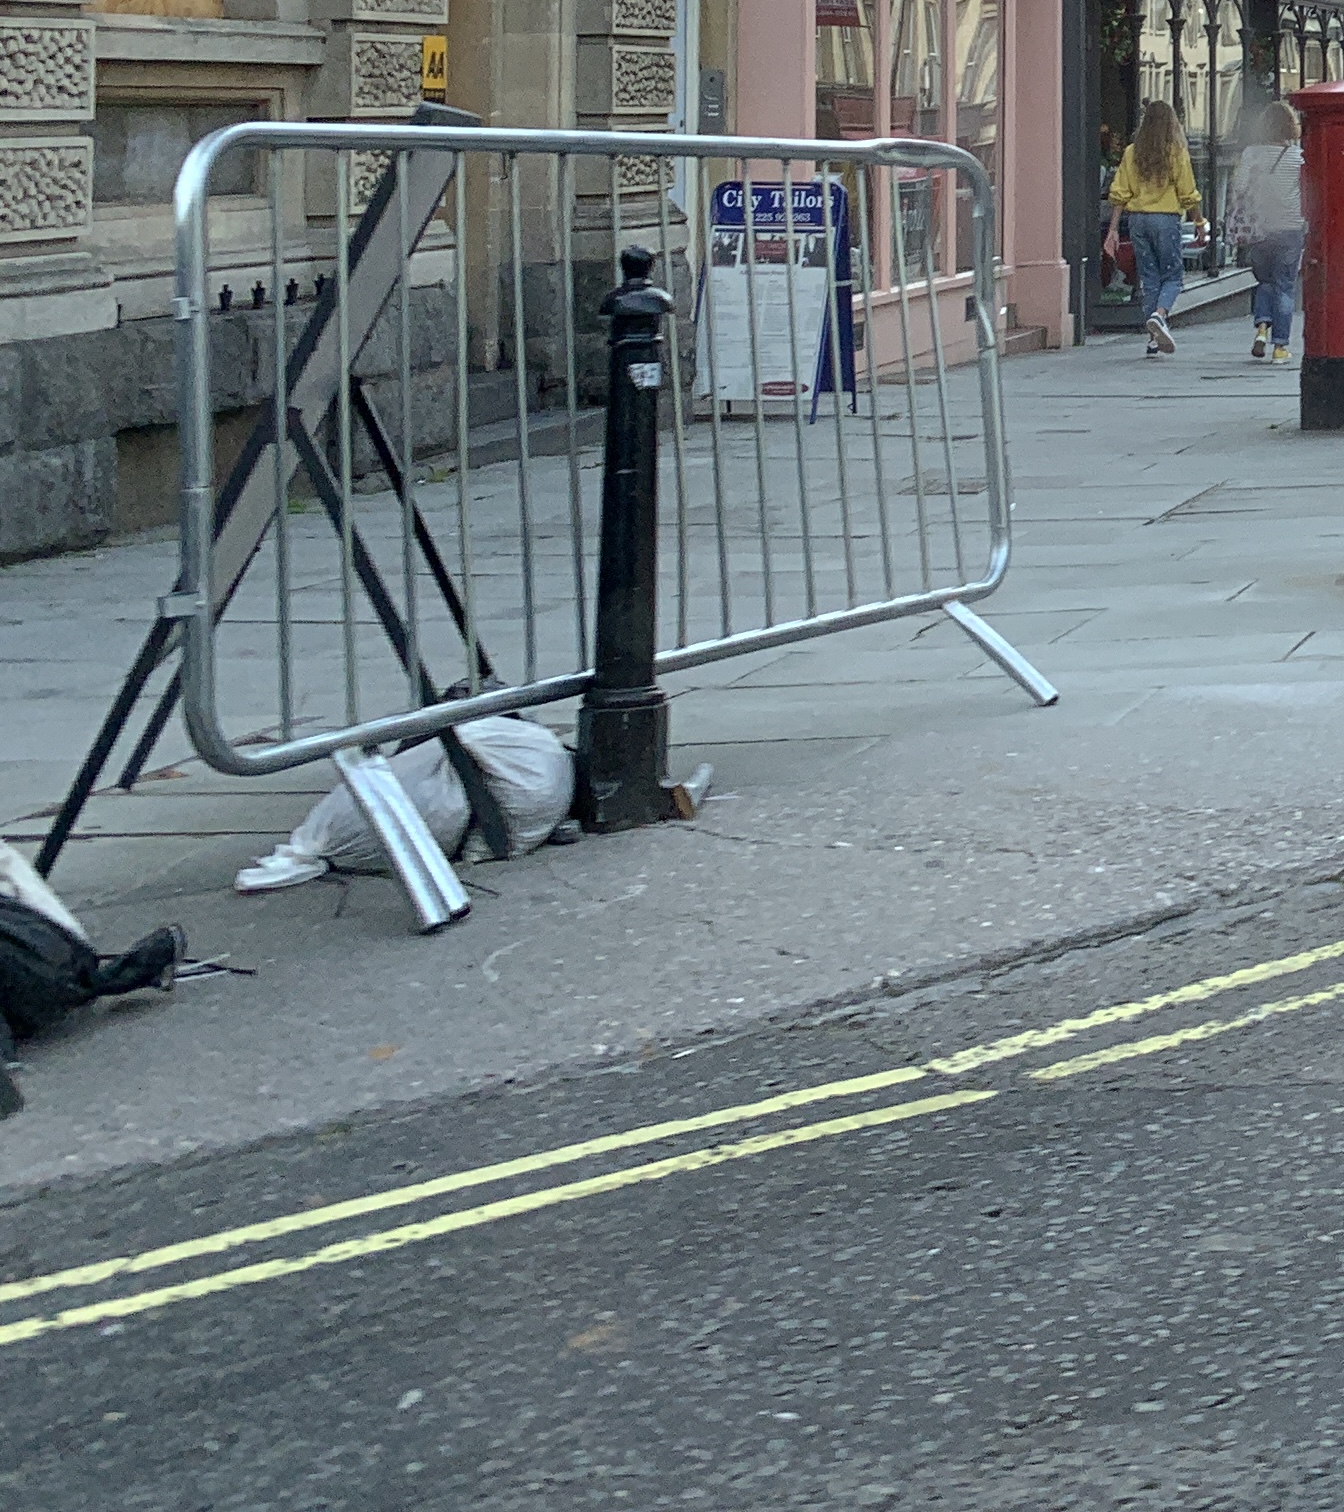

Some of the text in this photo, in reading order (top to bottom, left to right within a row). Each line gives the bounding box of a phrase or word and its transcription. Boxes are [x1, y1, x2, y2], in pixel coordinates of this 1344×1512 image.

[426, 51, 444, 79] AA
[722, 190, 835, 211] Ciy Tilors
